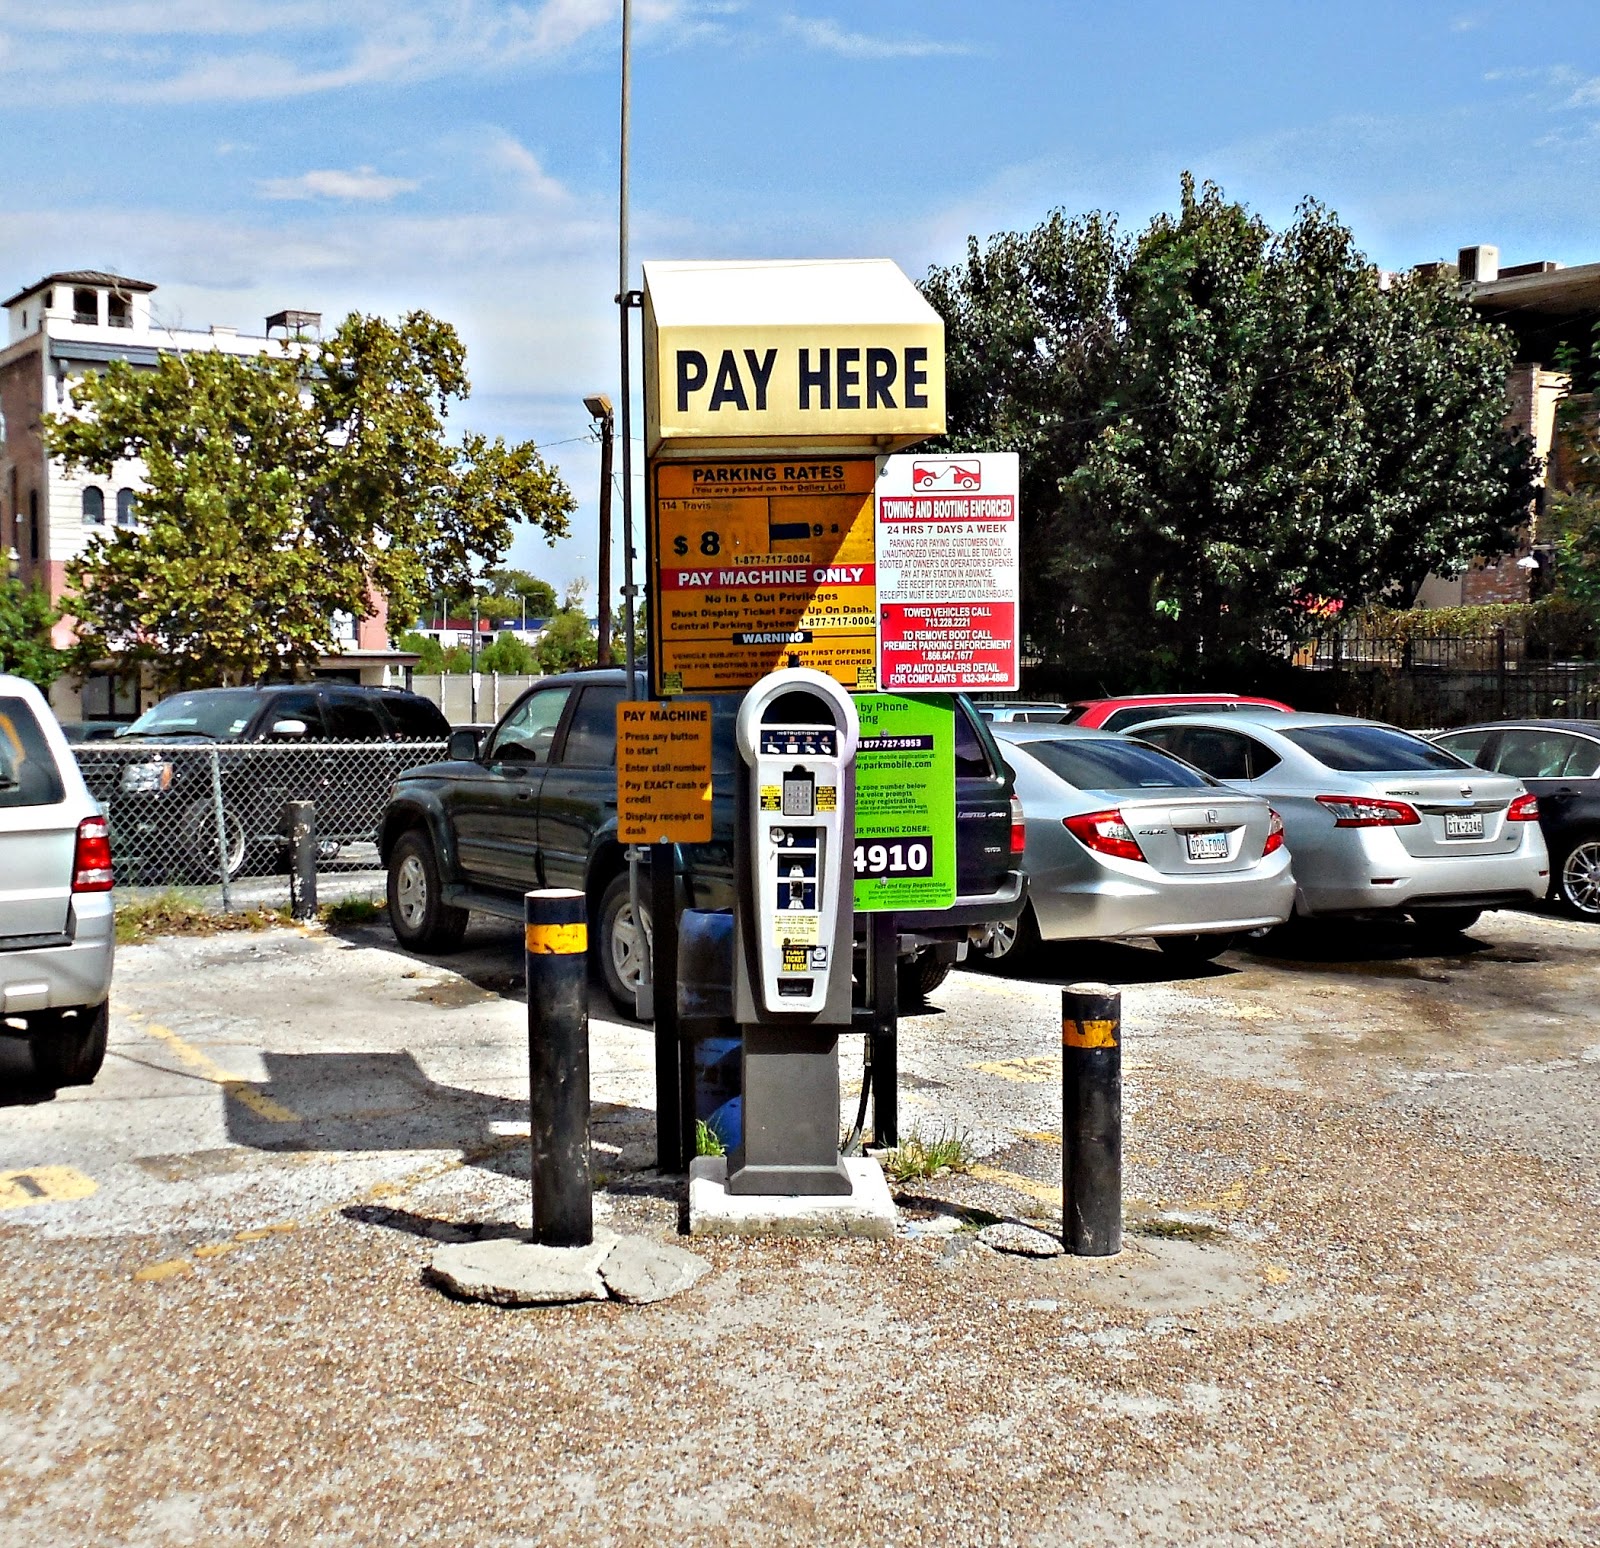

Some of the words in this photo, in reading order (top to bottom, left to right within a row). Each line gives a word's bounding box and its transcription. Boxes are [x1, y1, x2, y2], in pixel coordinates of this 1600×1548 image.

[676, 349, 778, 412] PAY
[799, 348, 928, 410] HERE
[693, 466, 777, 481] PARKING
[784, 466, 844, 479] RATES
[732, 484, 763, 494] parked
[683, 501, 711, 510] Travis
[883, 501, 913, 518] TOWING
[916, 501, 932, 517] AND
[935, 500, 968, 518] BOOTING
[970, 499, 1012, 516] ENFORCED
[887, 526, 899, 534] 24
[902, 526, 924, 534] HRS
[936, 525, 963, 533] DAYS
[967, 525, 973, 533] A
[978, 525, 1007, 533] WEEK
[673, 536, 688, 556] $
[700, 531, 720, 556] 8
[890, 539, 915, 548] PARKING
[916, 539, 928, 547] FOR
[929, 539, 950, 547] PAYING
[952, 539, 987, 547] CUSTOMERS
[882, 549, 926, 558] UNAUTHORIZED
[928, 549, 956, 558] VEHICLES
[957, 549, 970, 557] WILL
[971, 549, 980, 557] BE
[981, 548, 1001, 557] TOWED
[1003, 548, 1011, 557] OR
[734, 555, 811, 565] 1-877-717-0004
[879, 560, 903, 569] BOOTED
[905, 560, 912, 568] AT
[913, 559, 939, 568] OWNER'S
[941, 559, 949, 568] OR
[951, 559, 986, 568] OPERATOR'S
[679, 572, 714, 586] PAY
[720, 570, 807, 584] MACHINE
[813, 568, 864, 582] ONLY
[901, 570, 912, 579] PAY
[913, 570, 921, 578] AT
[921, 570, 932, 578] PAY
[933, 569, 957, 578] STATION
[897, 580, 908, 589] SEE
[909, 580, 932, 589] RECEIPT
[934, 580, 946, 589] FOR
[948, 579, 981, 589] EXPIRATION
[705, 595, 721, 603] No
[725, 594, 737, 603] In
[741, 594, 750, 602] &
[754, 594, 775, 602] Out
[779, 592, 838, 602] Privileges
[880, 590, 907, 599] RECEIPTS
[909, 590, 926, 599] MUST
[928, 590, 936, 599] BE
[937, 590, 966, 599] DISPLAYED
[968, 589, 976, 598] ON
[672, 609, 698, 618] Must
[700, 609, 739, 618] Display
[744, 608, 776, 616] Ticket
[779, 607, 804, 615] Face
[808, 607, 822, 615] Up
[825, 606, 839, 614] On
[843, 605, 872, 614] Dash.
[903, 608, 929, 617] TOWED
[931, 607, 970, 617] VEHICLES
[972, 607, 992, 616] CALL
[671, 622, 709, 630] Central
[713, 620, 753, 631] Parking
[756, 620, 795, 630] System
[800, 616, 876, 626] 1-877-717-0004
[742, 632, 804, 643] WARNING
[903, 631, 913, 640] TO
[915, 630, 948, 640] REMOVE
[949, 630, 970, 640] BOOT
[972, 629, 992, 639] CALL
[884, 641, 917, 651] PREMIER
[919, 641, 952, 650] PARKING
[955, 640, 1011, 650] ENFORCEMENT
[896, 664, 910, 673] HPD
[912, 663, 934, 673] AUTO
[936, 663, 971, 673] DEALERS
[973, 663, 999, 672] DETAIL
[890, 675, 906, 684] FOR
[907, 674, 957, 683] COMPLAINTS
[861, 703, 873, 714] by
[876, 702, 909, 711] Phone
[623, 711, 645, 721] PAY
[650, 711, 707, 722] MACHINE
[653, 734, 667, 743] any
[625, 747, 634, 755] to
[637, 747, 658, 755] start
[625, 764, 648, 772] Enter
[652, 764, 670, 772] stall
[673, 764, 705, 772] number
[625, 781, 641, 791] Pay
[644, 781, 673, 789] EXACT
[676, 781, 697, 789] cash
[625, 796, 651, 804] credit
[625, 812, 657, 822] Display
[660, 813, 691, 823] receipt
[866, 826, 900, 834] PARKING
[902, 825, 930, 833] ZONE#:
